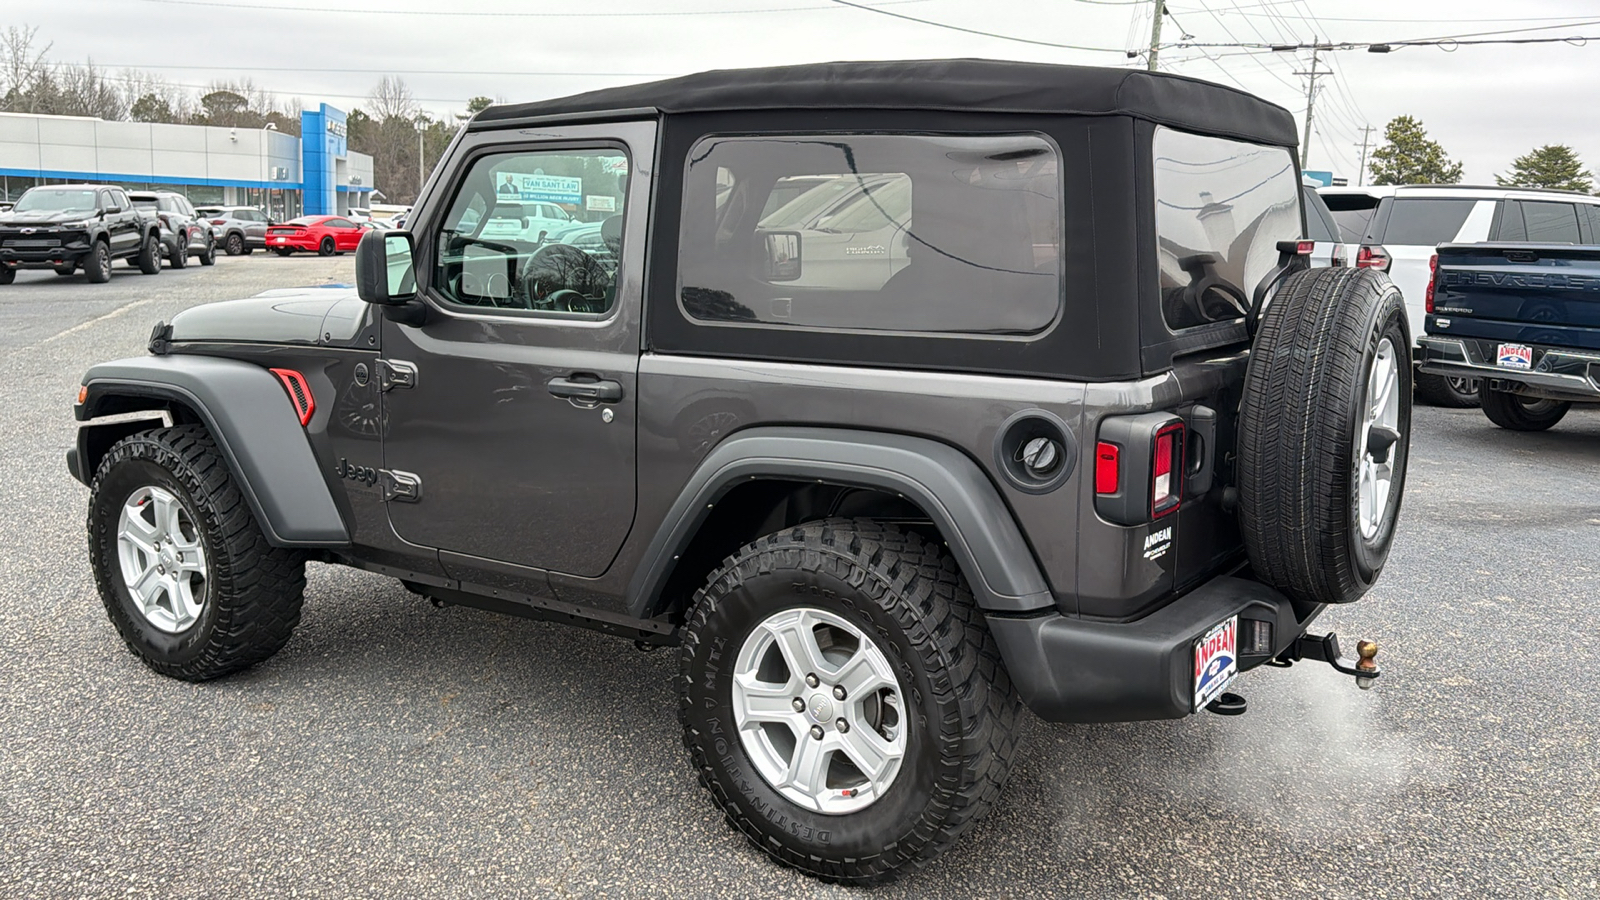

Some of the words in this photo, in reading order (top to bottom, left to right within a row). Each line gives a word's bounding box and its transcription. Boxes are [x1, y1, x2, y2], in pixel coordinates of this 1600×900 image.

[525, 180, 541, 188] VAN
[562, 182, 577, 190] LAW
[1499, 347, 1530, 362] ANDEAN
[335, 457, 377, 488] Jeep
[1143, 526, 1172, 550] ANDEAN
[1195, 620, 1236, 679] ANDEAN
[706, 717, 832, 846] DESTINATION
